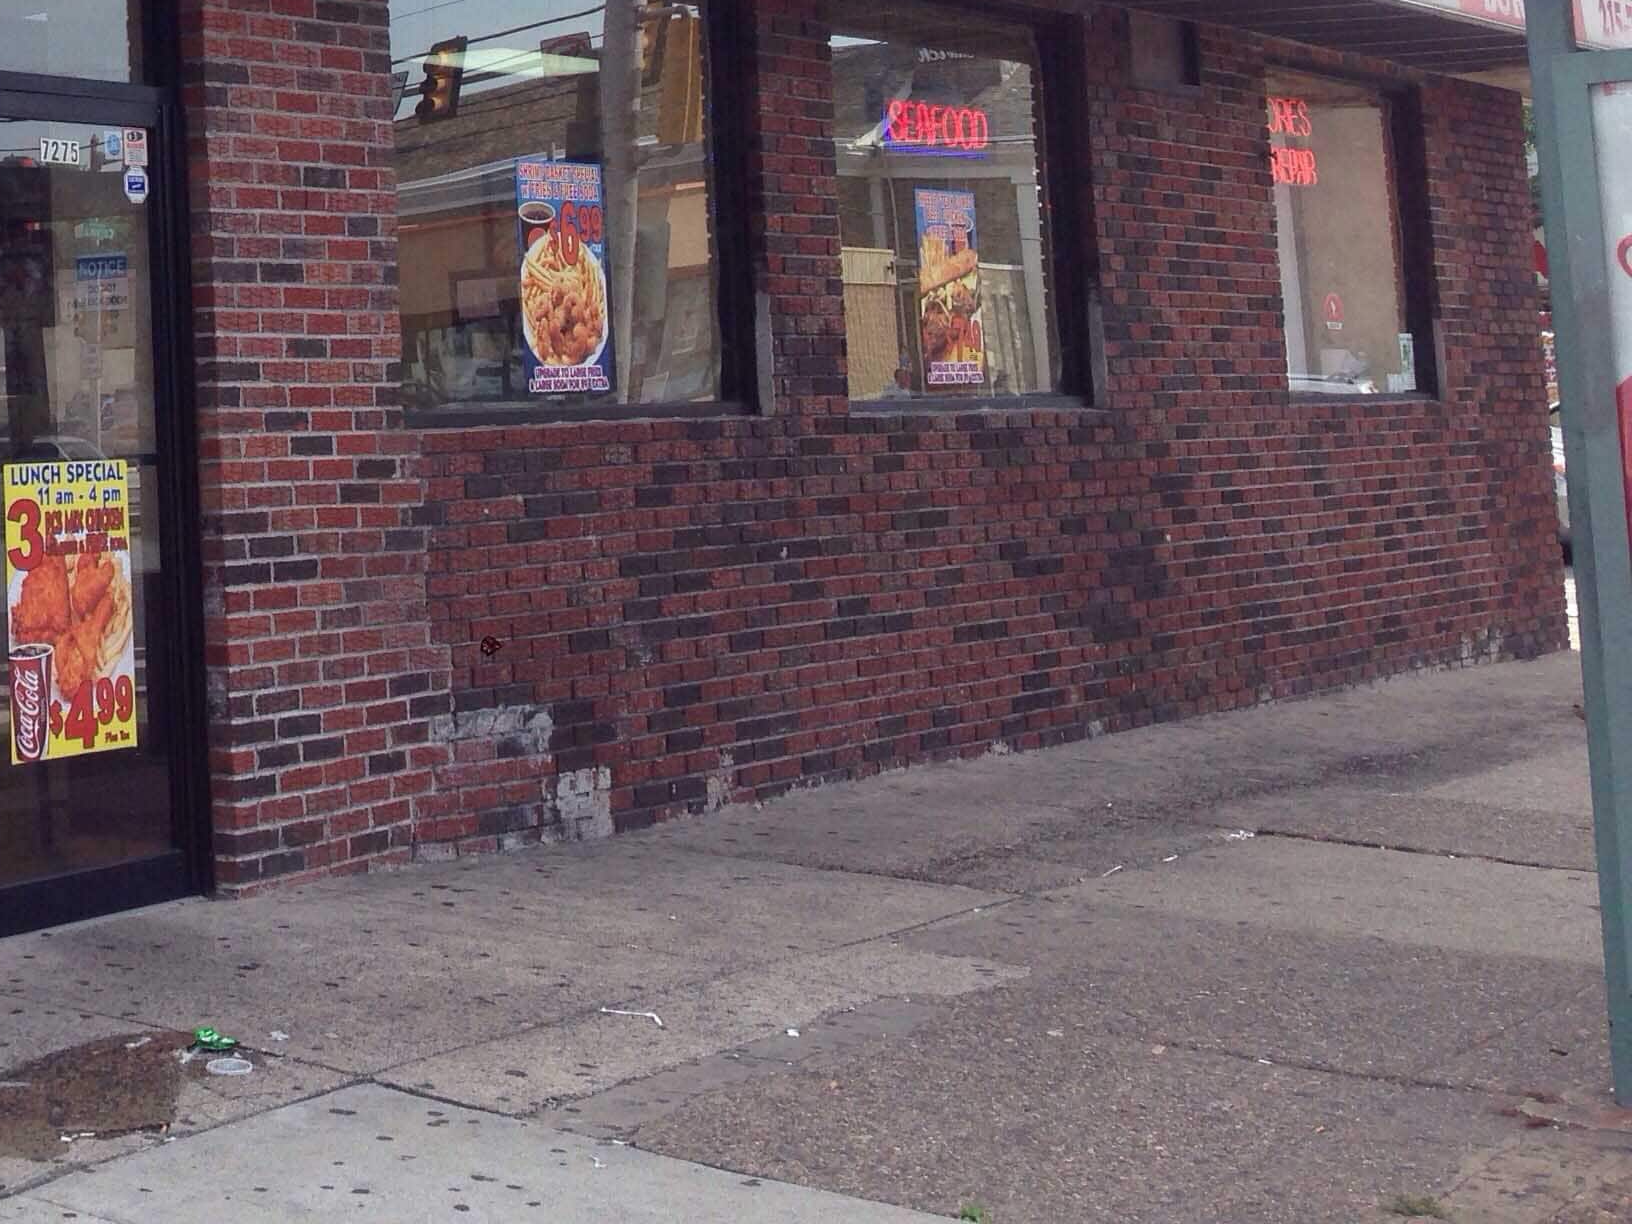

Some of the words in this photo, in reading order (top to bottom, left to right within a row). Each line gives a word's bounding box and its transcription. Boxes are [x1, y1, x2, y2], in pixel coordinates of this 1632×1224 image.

[888, 100, 988, 150] SEAFOOD
[42, 140, 78, 162] 7275
[79, 259, 125, 276] NOTICE
[11, 464, 61, 486] LUNCH
[66, 461, 124, 484] SPECIAL
[38, 487, 50, 505] 11
[56, 490, 74, 504] am
[89, 485, 97, 502] 4
[103, 488, 121, 508] pm
[7, 498, 44, 571] 3
